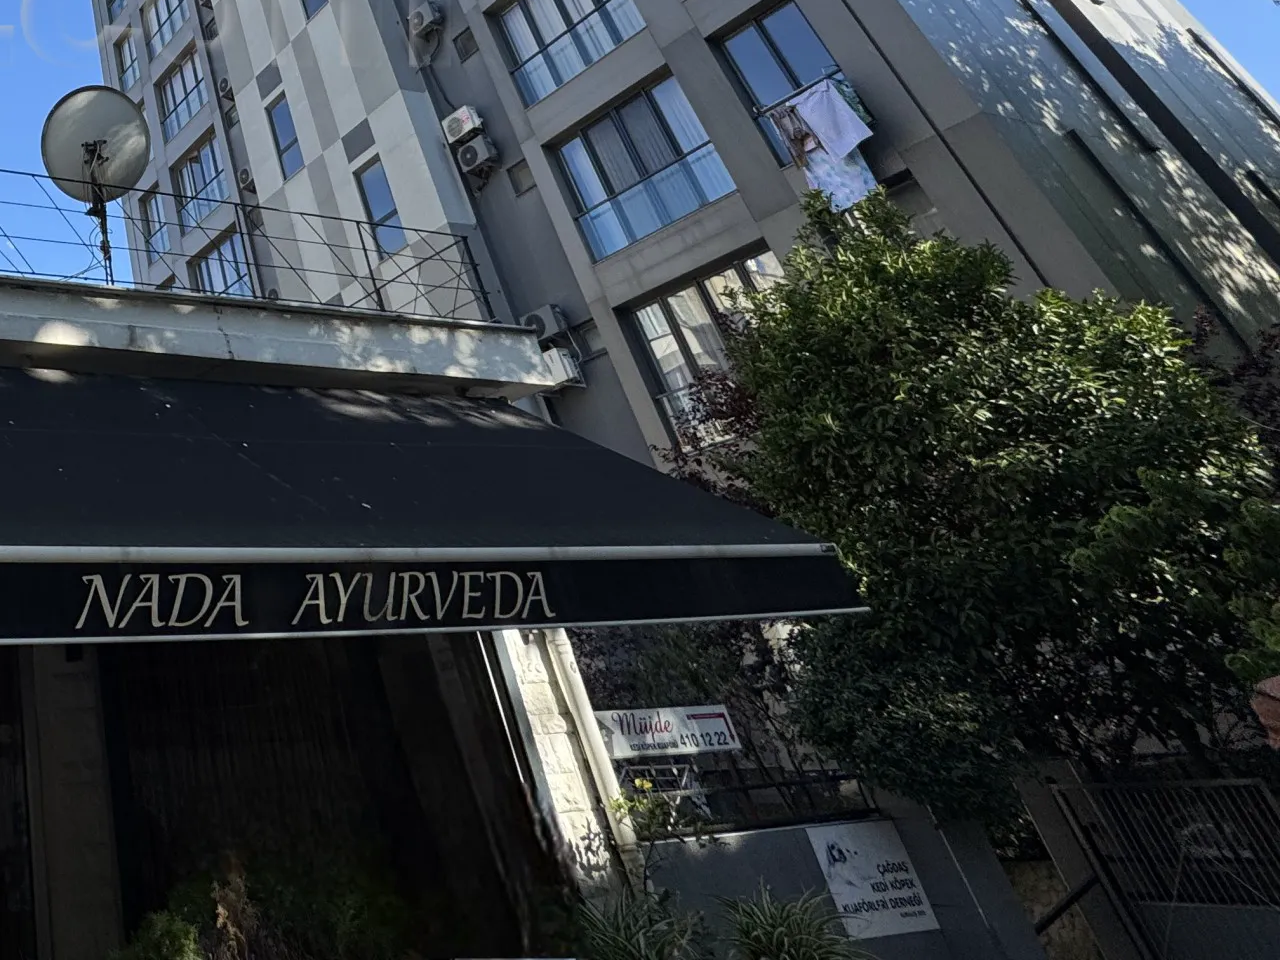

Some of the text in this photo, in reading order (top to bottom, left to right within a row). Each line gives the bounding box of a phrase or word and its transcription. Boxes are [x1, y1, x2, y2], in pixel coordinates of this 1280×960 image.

[75, 570, 556, 629] NADA AYURVEDA
[611, 711, 673, 743] Müjde
[679, 732, 700, 749] 410
[700, 731, 715, 747] 12
[714, 730, 730, 747] 22
[876, 860, 909, 877] ÇAĞDAŞ
[870, 877, 917, 894] KEDİ KÖPEK
[889, 892, 925, 909] DERNEĞİ
